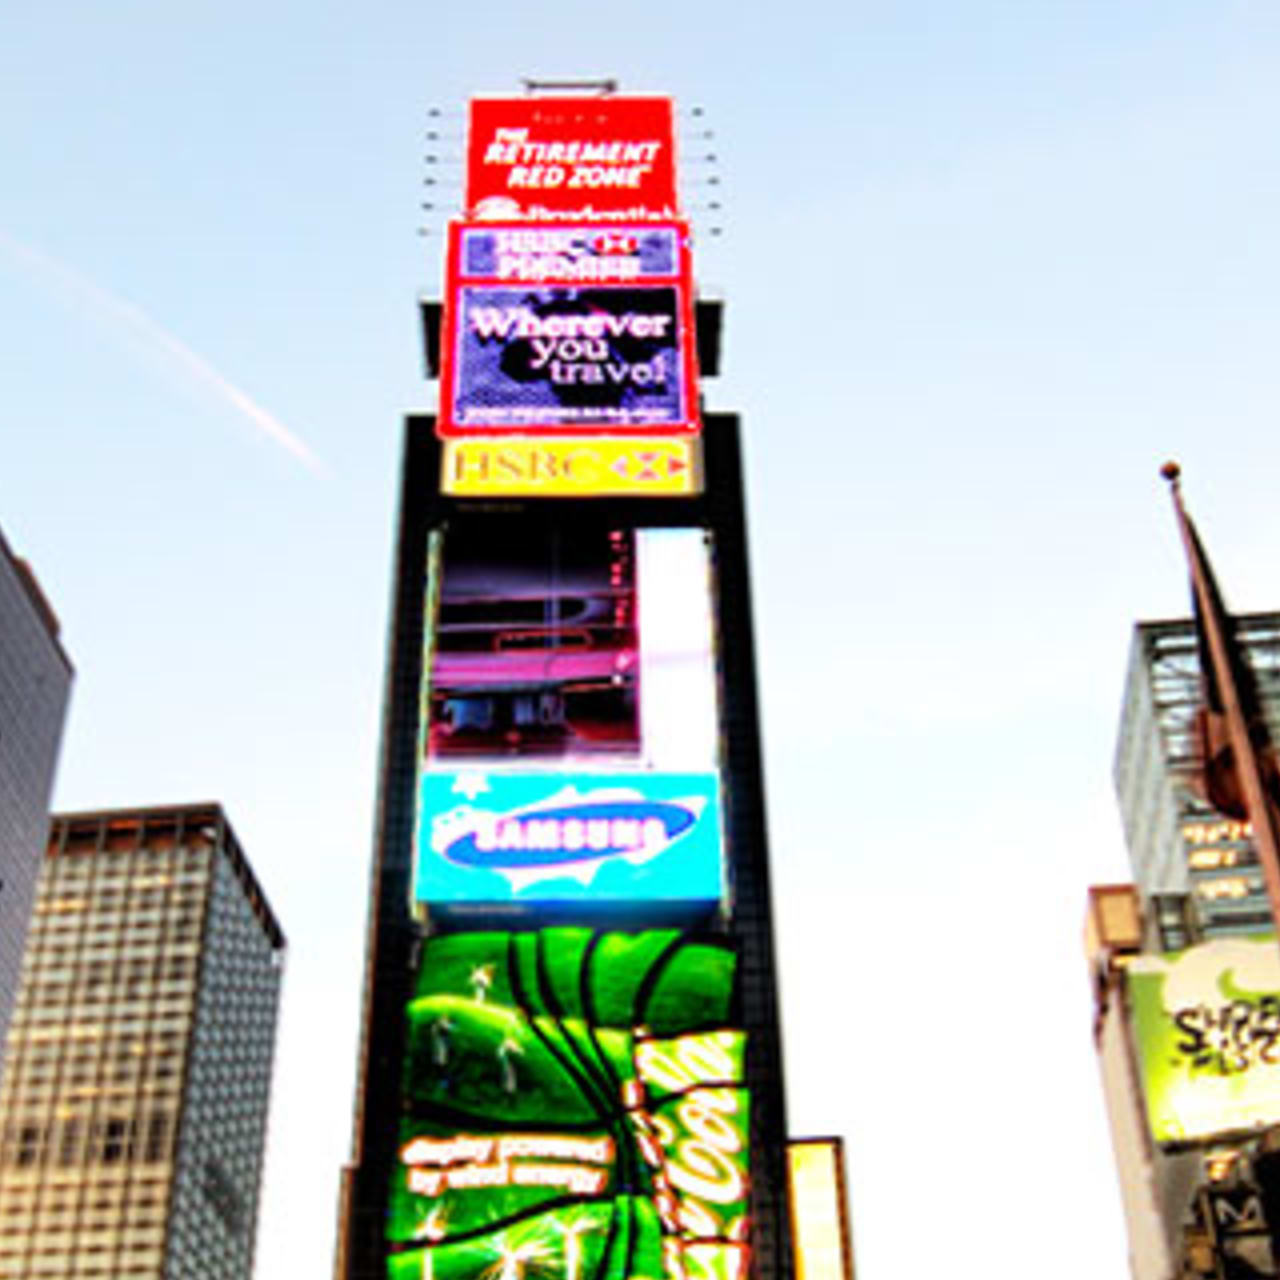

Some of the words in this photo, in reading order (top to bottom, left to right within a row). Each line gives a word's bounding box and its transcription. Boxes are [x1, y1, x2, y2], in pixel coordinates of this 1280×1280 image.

[483, 141, 662, 166] RETIREMENT
[507, 166, 565, 189] RED
[568, 165, 644, 189] ZONE
[469, 307, 672, 340] Wherever
[529, 340, 610, 370] you
[549, 358, 667, 385] travel
[455, 449, 602, 483] HSBC
[473, 815, 669, 853] SAMSUNG
